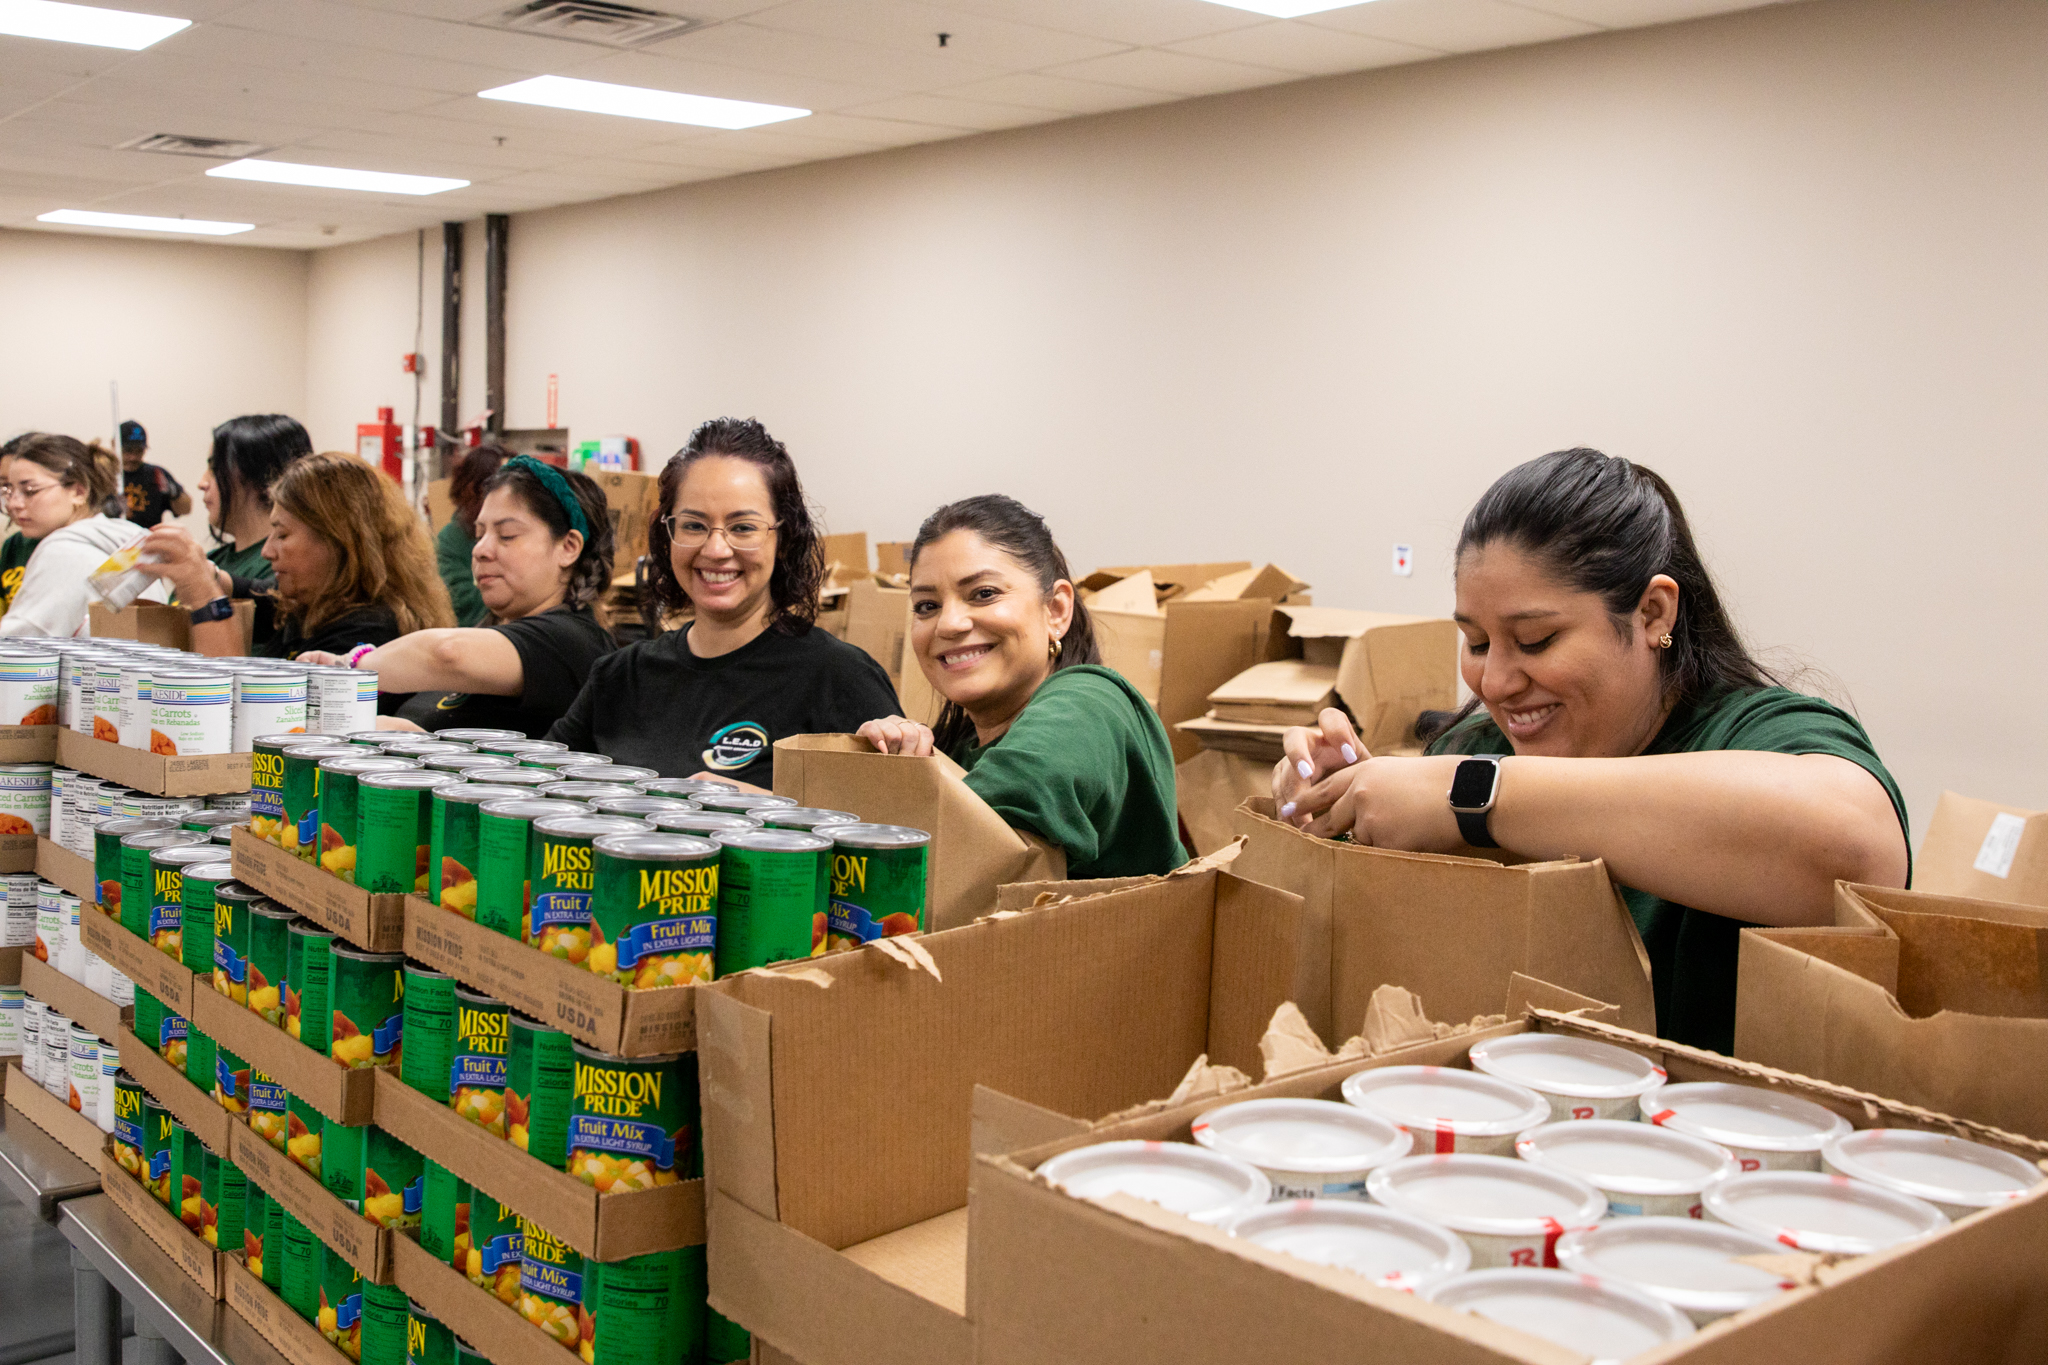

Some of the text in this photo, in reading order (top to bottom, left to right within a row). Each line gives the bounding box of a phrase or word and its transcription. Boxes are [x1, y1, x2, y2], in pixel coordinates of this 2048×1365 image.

[102, 695, 120, 704] Carr
[159, 708, 192, 718] Carrots
[722, 737, 761, 747] L.E.A.D
[253, 752, 284, 777] ISSIO
[0, 777, 44, 786] AKESIDE
[14, 794, 47, 802] Carrots
[541, 842, 594, 880] MISS
[555, 872, 594, 890] PRI
[638, 864, 720, 910] MISSION
[550, 896, 580, 910] Fruit
[658, 895, 711, 916] PRIDE
[326, 907, 351, 932] USDA
[552, 911, 573, 920] EXTRA
[651, 919, 712, 939] Fruit Mix
[834, 918, 857, 931] SYRUP
[643, 942, 653, 950] IN
[654, 939, 677, 949] EXTRA
[679, 936, 700, 946] LIGHT
[307, 975, 328, 983] Calori
[160, 981, 180, 1004] USDA
[430, 987, 452, 997] Facts
[172, 1019, 187, 1029] Fru
[439, 1019, 452, 1028] 70
[458, 1006, 509, 1042] MISSI
[557, 1002, 597, 1036] USDA
[468, 1036, 508, 1054] PRID
[539, 1042, 572, 1051] Nutritio
[463, 1059, 491, 1073] Fruit
[538, 1077, 570, 1086] Calorie
[574, 1061, 663, 1110] MISSION
[252, 1087, 271, 1099] Fruit
[115, 1087, 140, 1116] SION
[267, 1099, 284, 1107] LIGHT
[584, 1095, 643, 1117] PRIDE
[118, 1121, 131, 1134] Mix
[579, 1118, 645, 1140] Fruit Mix
[581, 1135, 601, 1144] EXTRA
[602, 1136, 625, 1147] LIGHT
[626, 1140, 652, 1152] SYRUP
[1279, 1184, 1315, 1199] Facts
[332, 1227, 358, 1259] USDA
[301, 1247, 311, 1255] 70
[524, 1238, 567, 1264] PRIDE
[643, 1264, 669, 1272] Facts
[540, 1268, 568, 1287] Mix
[533, 1280, 576, 1297] LIGHT SYRUP
[603, 1295, 669, 1307] Calories 70
[394, 1314, 407, 1323] 70
